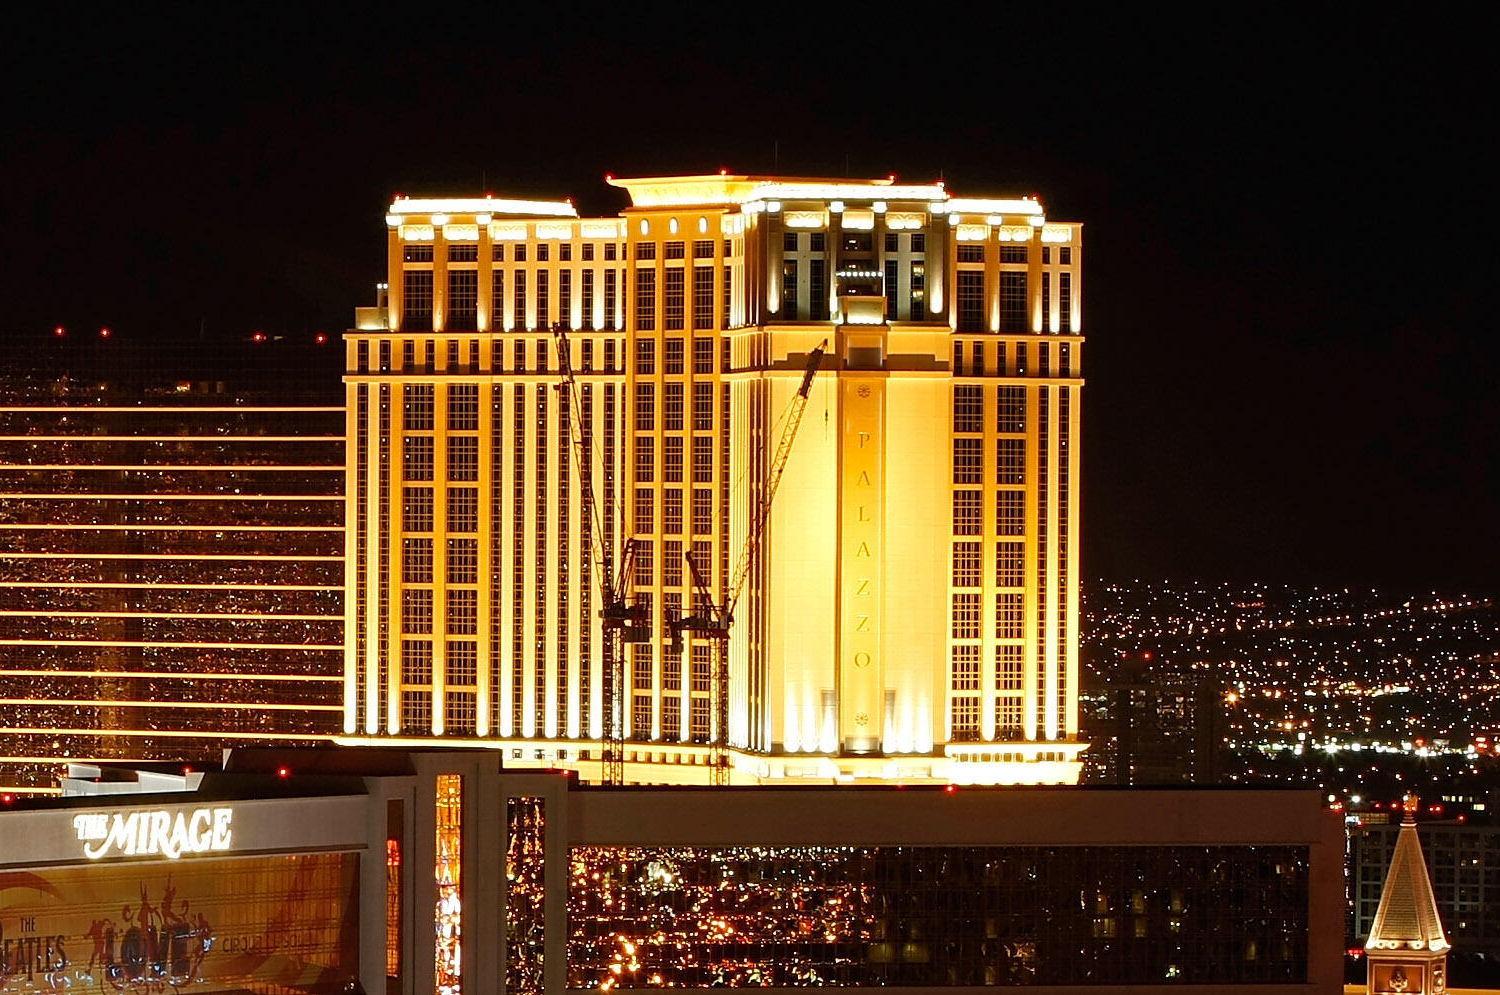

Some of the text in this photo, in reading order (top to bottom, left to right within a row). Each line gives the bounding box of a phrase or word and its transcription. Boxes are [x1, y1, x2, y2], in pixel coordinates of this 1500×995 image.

[854, 433, 870, 667] PALAZZO
[73, 808, 233, 859] THE MIRAGE
[20, 917, 36, 932] THE
[103, 925, 192, 981] LOVE
